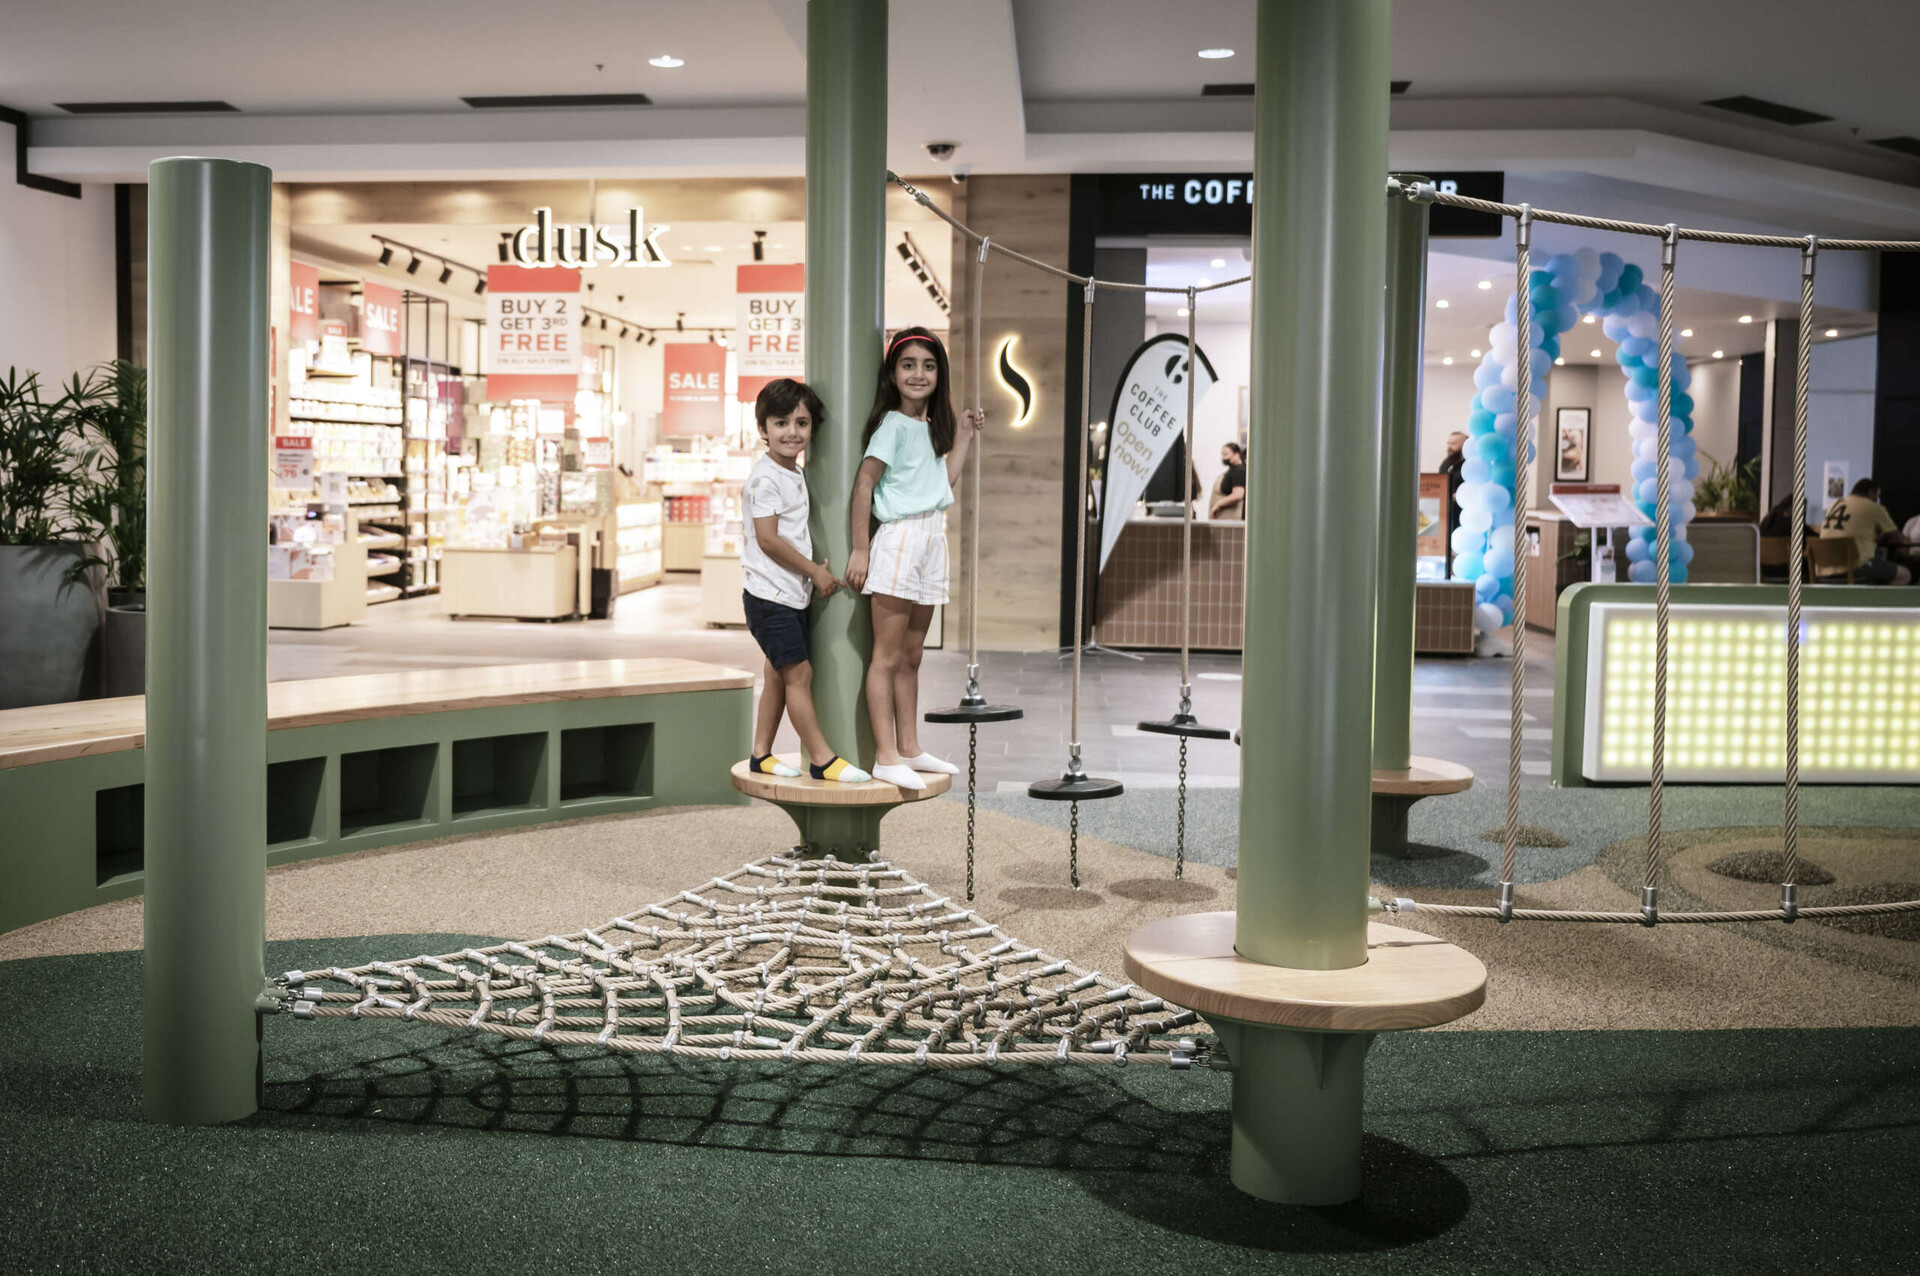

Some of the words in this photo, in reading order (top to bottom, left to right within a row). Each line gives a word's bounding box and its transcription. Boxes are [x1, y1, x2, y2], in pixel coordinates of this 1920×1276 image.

[1139, 183, 1175, 200] THE
[513, 205, 672, 269] dusk
[501, 299, 546, 314] BUY
[555, 299, 567, 314] 2
[750, 299, 797, 315] BUY
[366, 302, 398, 333] SALE
[500, 317, 536, 330] GET
[541, 317, 568, 330] 3RD
[748, 318, 784, 331] GET
[500, 333, 568, 351] FREE
[748, 334, 801, 352] FRE
[669, 372, 720, 390] SALE
[1153, 386, 1168, 401] THE
[1130, 383, 1177, 430] COFFEE
[1129, 404, 1161, 437] CLUB
[282, 438, 307, 448] SALE
[1116, 421, 1153, 461] Open
[1113, 444, 1152, 480] now!
